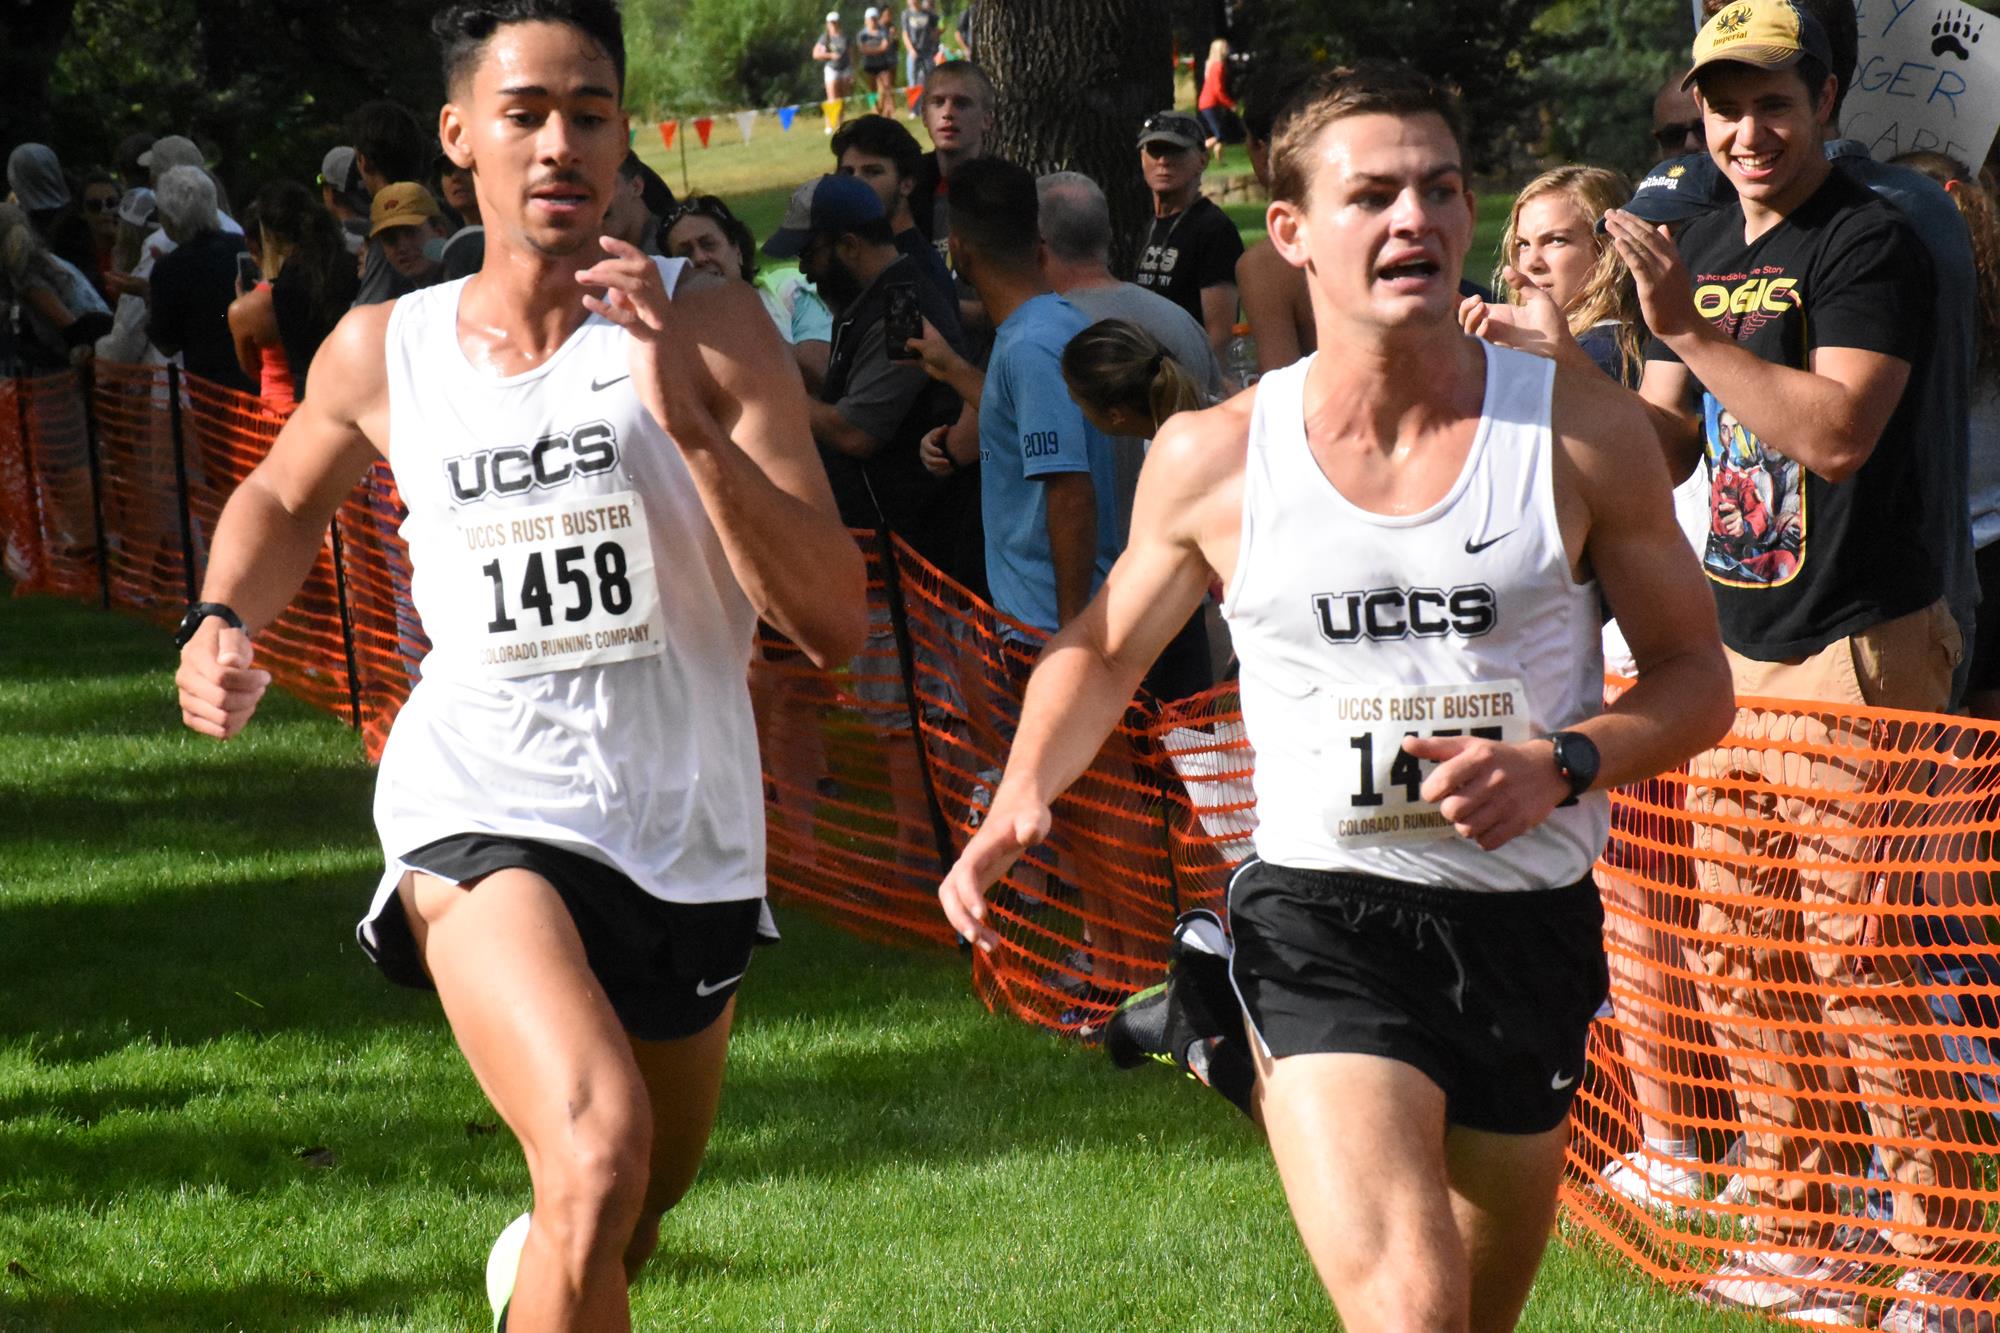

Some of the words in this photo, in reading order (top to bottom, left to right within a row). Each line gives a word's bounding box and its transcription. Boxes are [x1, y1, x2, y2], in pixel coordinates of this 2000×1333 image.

[1713, 30, 1748, 47] Imperial
[1762, 265, 1784, 274] Story
[1693, 278, 1799, 318] OGIC
[443, 419, 620, 505] UCCS
[1023, 431, 1059, 458] 2019
[465, 524, 506, 550] UCCS
[512, 516, 555, 544] RUST
[562, 504, 632, 536] BUSTER
[482, 541, 632, 634] 1458
[1312, 583, 1496, 644] UCCS
[480, 641, 538, 664] COLORADO
[541, 634, 593, 656] RUNNING
[596, 624, 650, 649] COMPANY
[1338, 698, 1383, 720] UCCS
[1390, 696, 1437, 720] RUST
[1443, 692, 1514, 719] BUSTER
[1350, 725, 1503, 807] 14
[1338, 816, 1400, 837] COLORADO
[1403, 810, 1454, 830] RUNNIN
